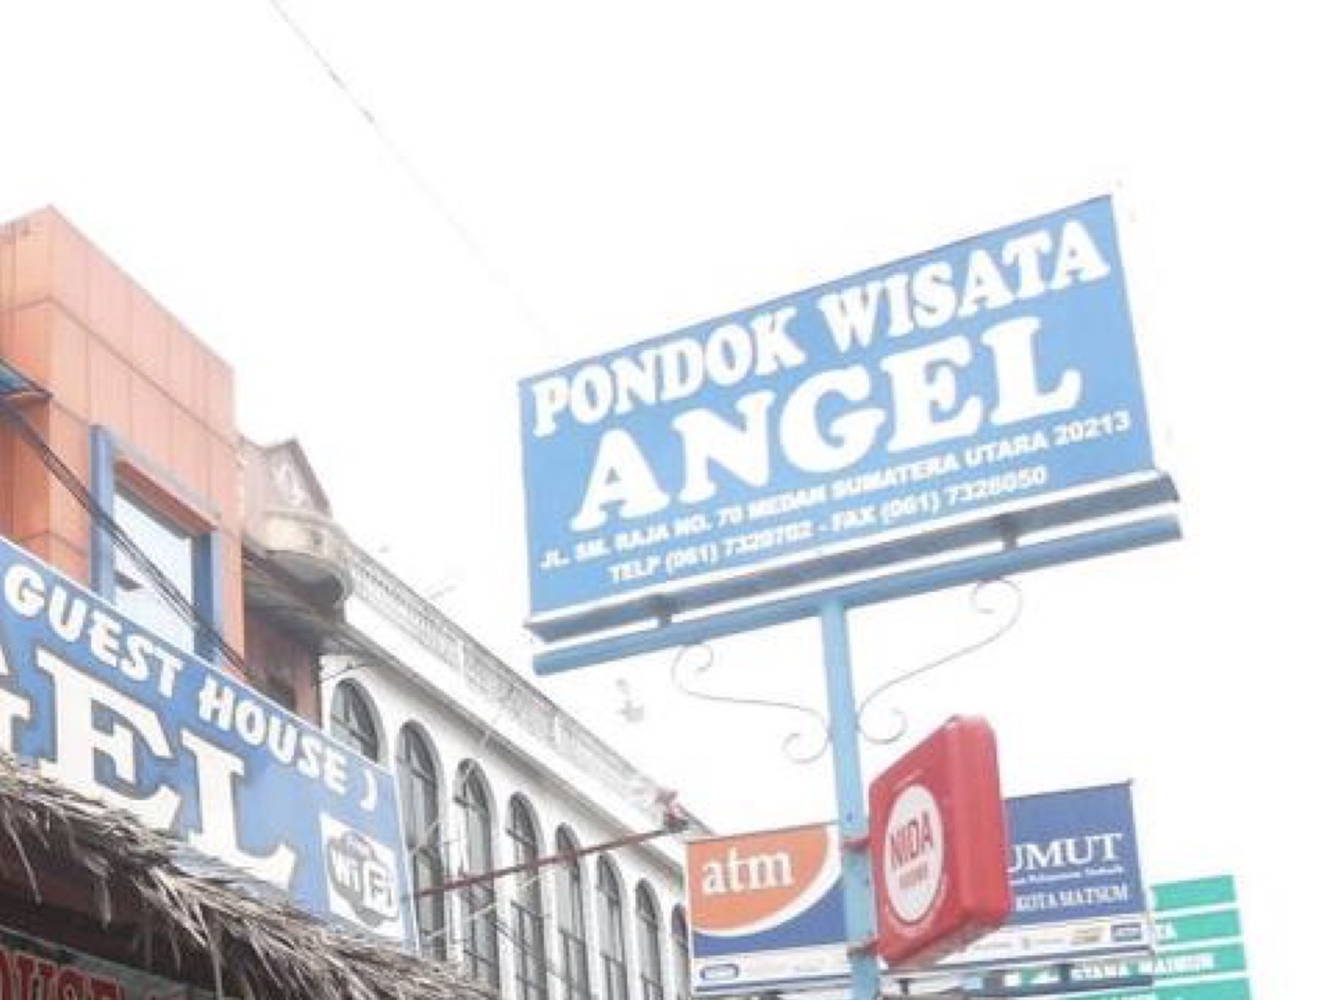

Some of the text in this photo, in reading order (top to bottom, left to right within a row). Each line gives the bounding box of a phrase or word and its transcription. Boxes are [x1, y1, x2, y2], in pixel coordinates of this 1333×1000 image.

[532, 220, 1111, 438] PONDOK WISATA
[571, 316, 1082, 530] ANGEL
[831, 452, 960, 498] SUMATERA
[966, 431, 1049, 467] UTARA
[1053, 411, 1131, 446] 20213
[4, 566, 184, 697] GUEST
[199, 679, 352, 794] HOUSE
[701, 846, 794, 897] atm
[1006, 833, 1123, 872] UMUT
